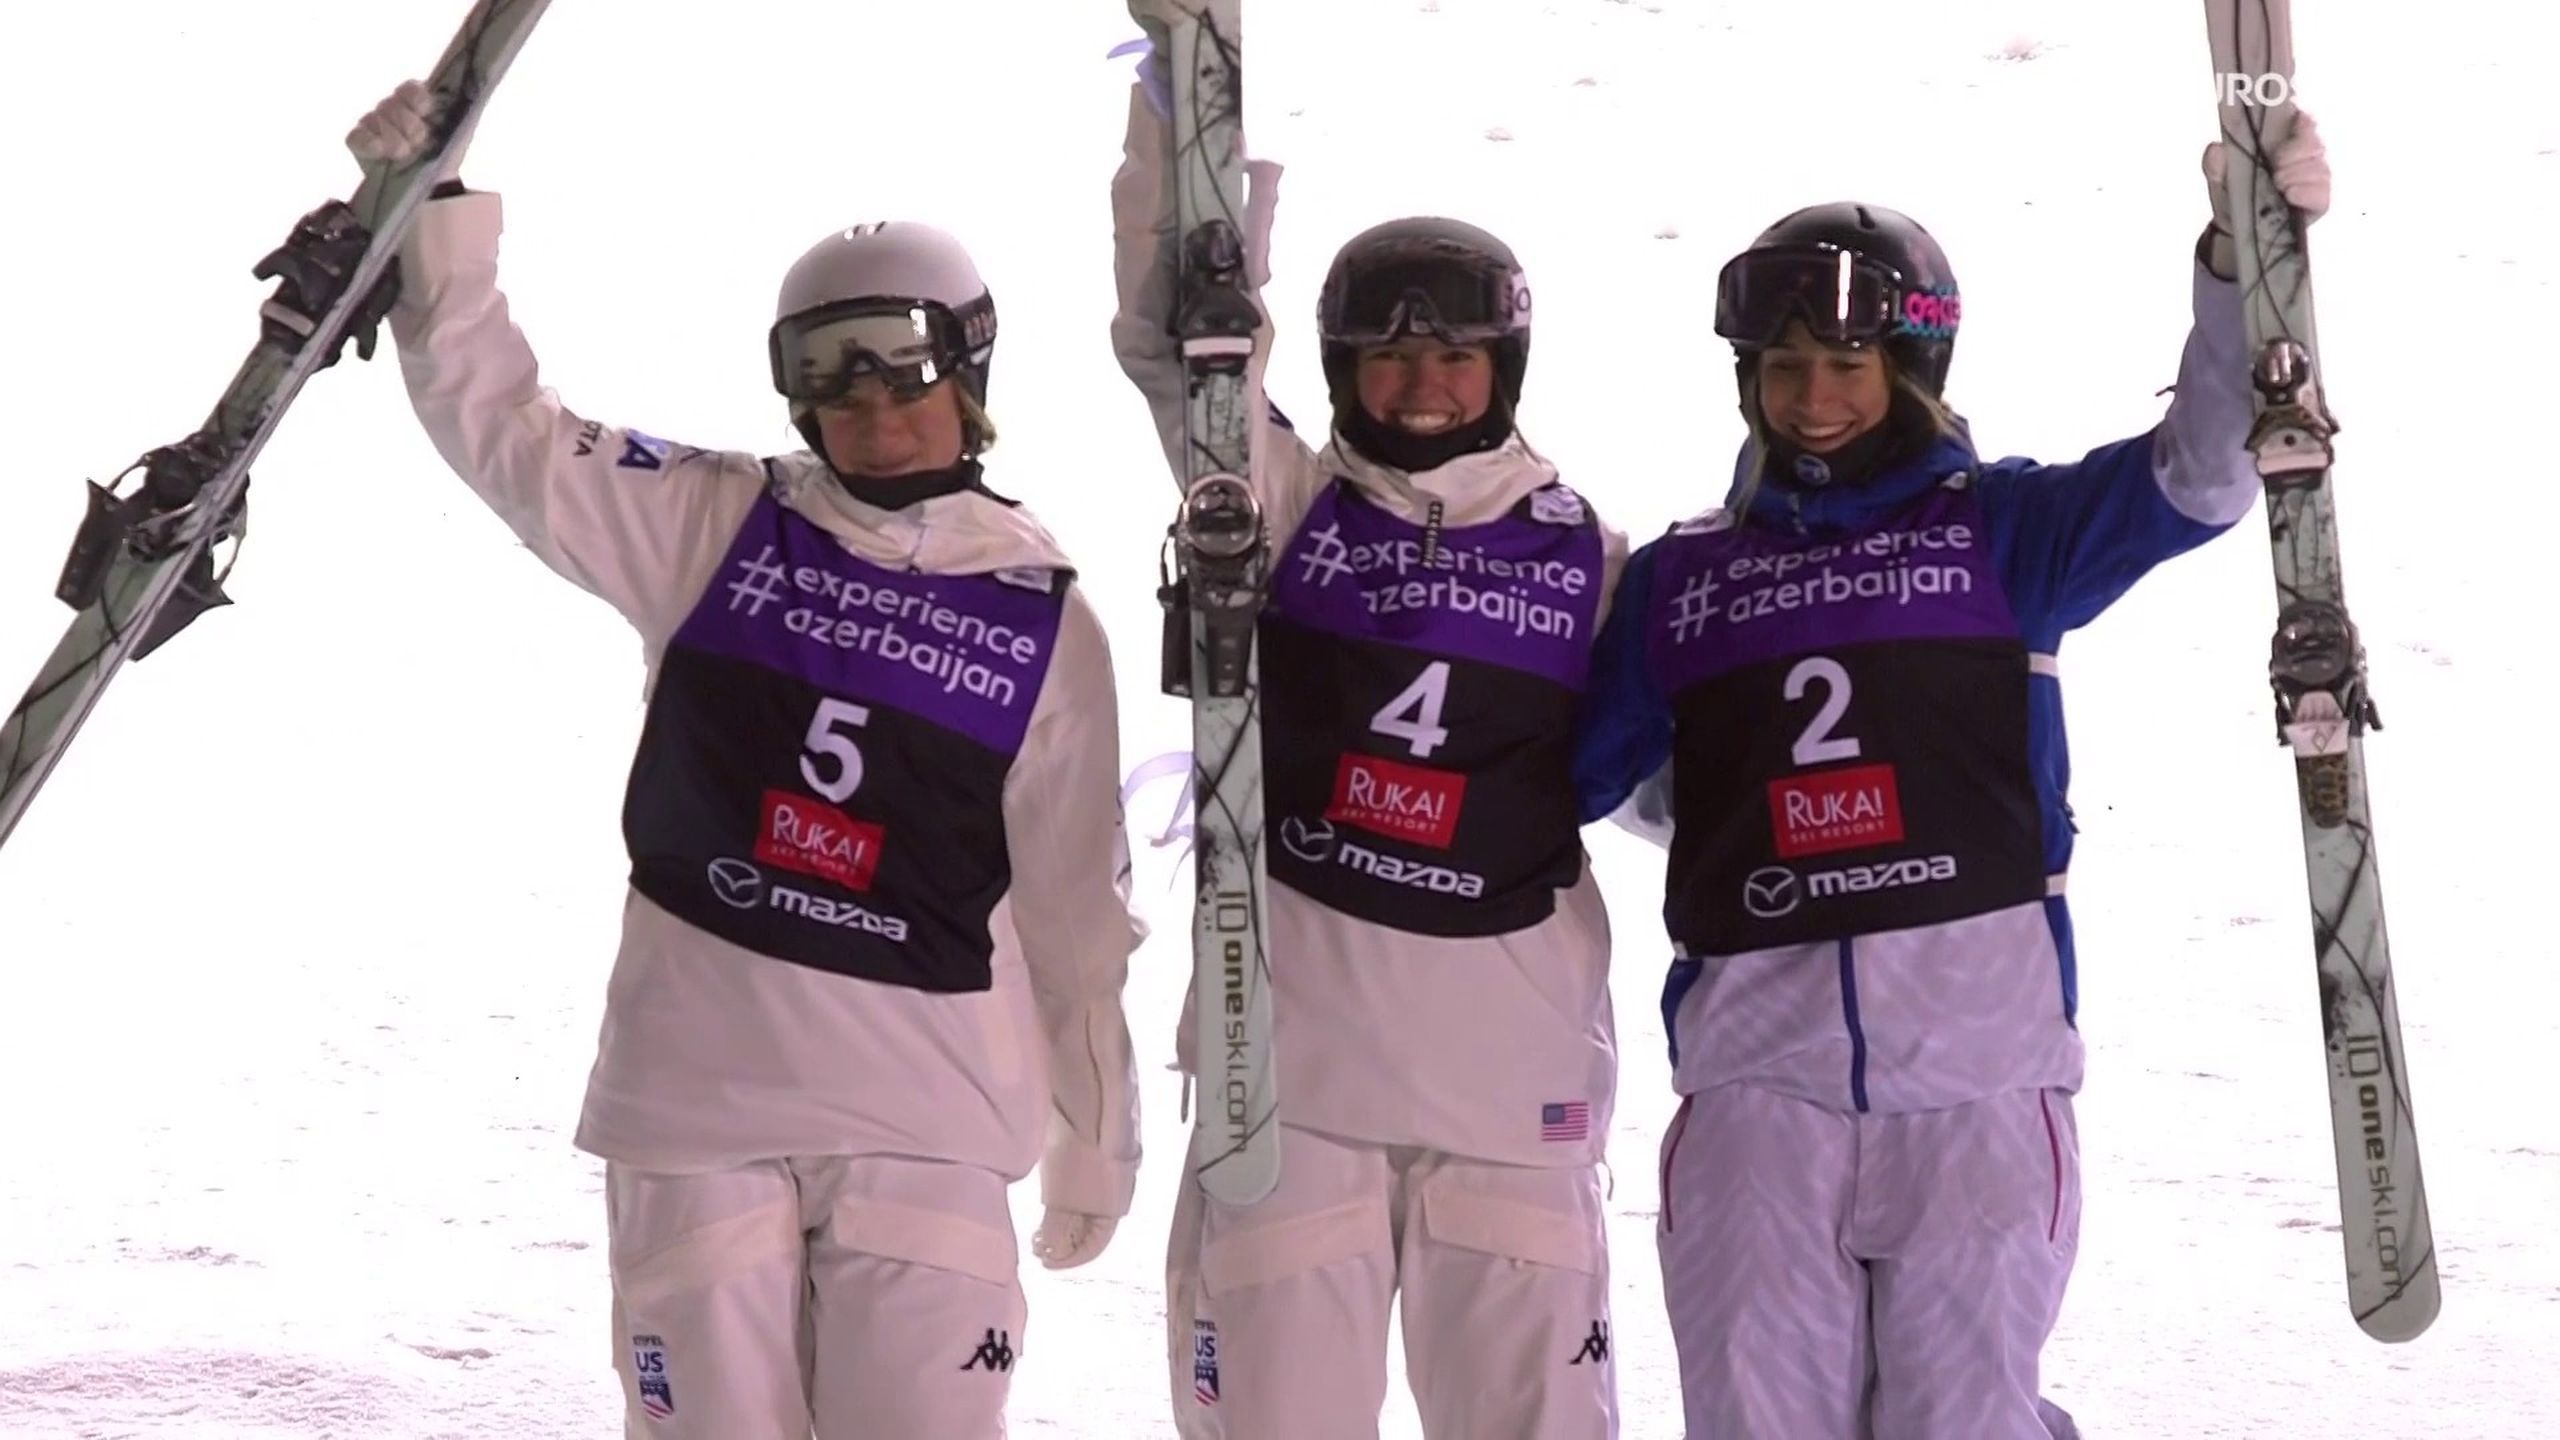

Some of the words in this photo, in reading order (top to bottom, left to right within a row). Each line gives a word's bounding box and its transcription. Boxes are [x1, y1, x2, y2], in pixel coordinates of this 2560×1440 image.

[793, 565, 1037, 664] experience
[1727, 557, 1972, 623] azerbaijan
[783, 607, 1016, 707] azerbaijan
[800, 697, 871, 803] 5
[1369, 660, 1451, 758] 4
[1783, 656, 1861, 766] 2
[1347, 767, 1446, 821] RUKA!
[1784, 786, 1885, 830] RUKA!
[635, 1350, 664, 1373] US
[1194, 1334, 1216, 1357] US
